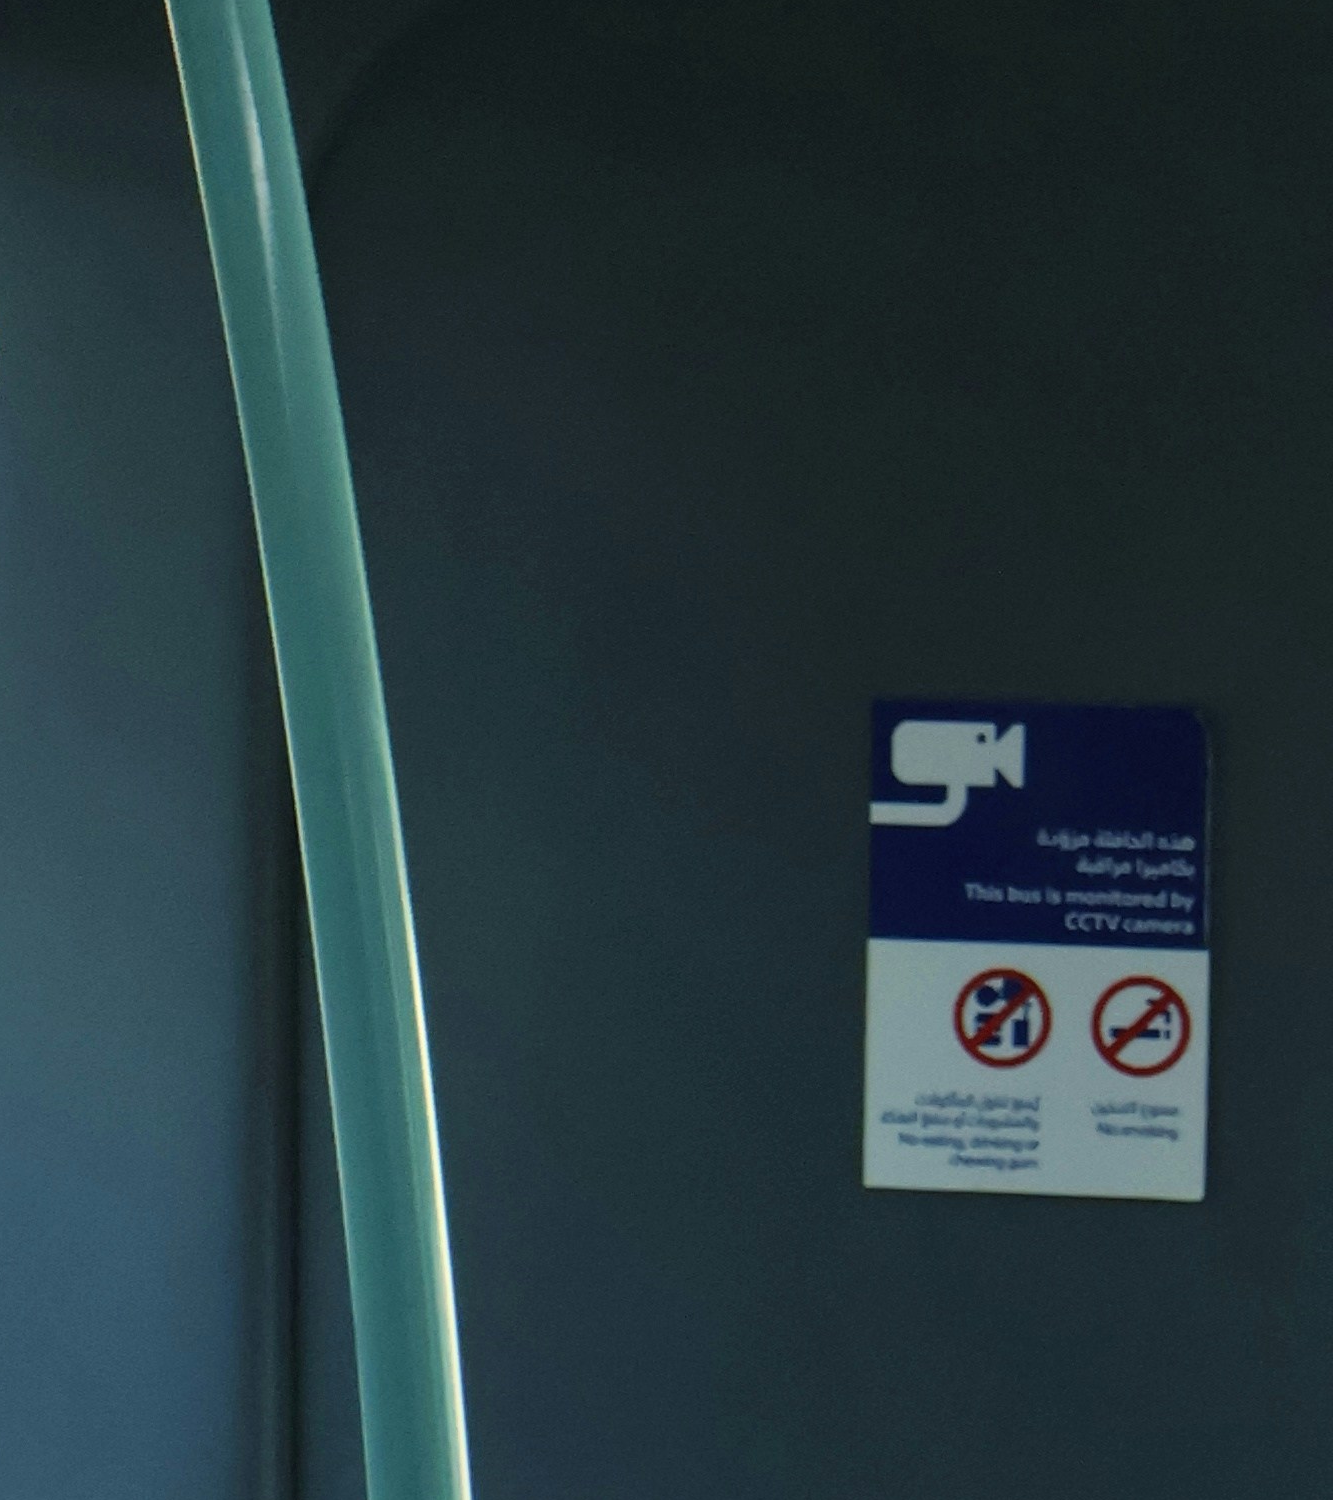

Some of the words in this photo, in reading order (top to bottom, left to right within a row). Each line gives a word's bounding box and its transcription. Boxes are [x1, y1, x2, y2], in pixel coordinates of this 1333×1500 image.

[965, 882, 1004, 903] This
[1007, 886, 1042, 904] bus
[1045, 885, 1062, 905] is
[1065, 888, 1167, 908] monitored
[1170, 890, 1195, 913] by
[1064, 911, 1121, 932] CCTV
[1122, 918, 1195, 935] camera
